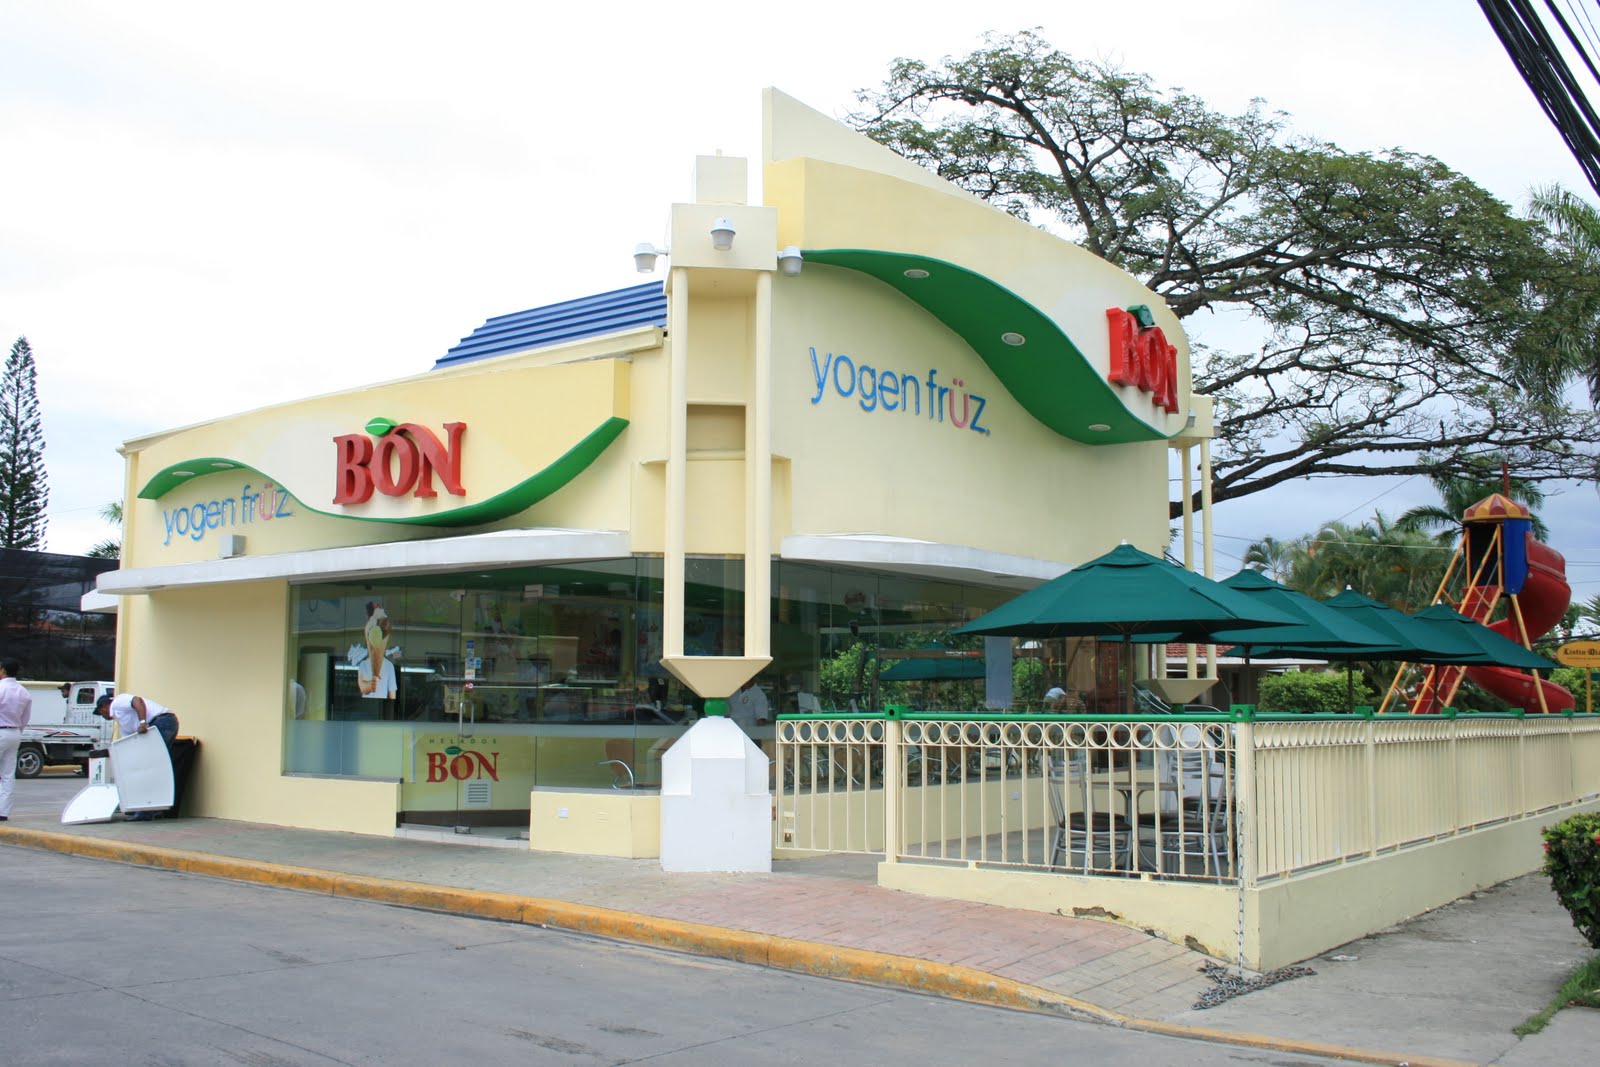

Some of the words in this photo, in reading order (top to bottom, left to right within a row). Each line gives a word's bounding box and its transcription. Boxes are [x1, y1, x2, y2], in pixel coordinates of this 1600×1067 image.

[809, 346, 920, 415] yogen
[1105, 307, 1179, 414] BON
[333, 420, 467, 506] BON
[163, 497, 237, 546] yogen
[426, 750, 499, 783] BON
